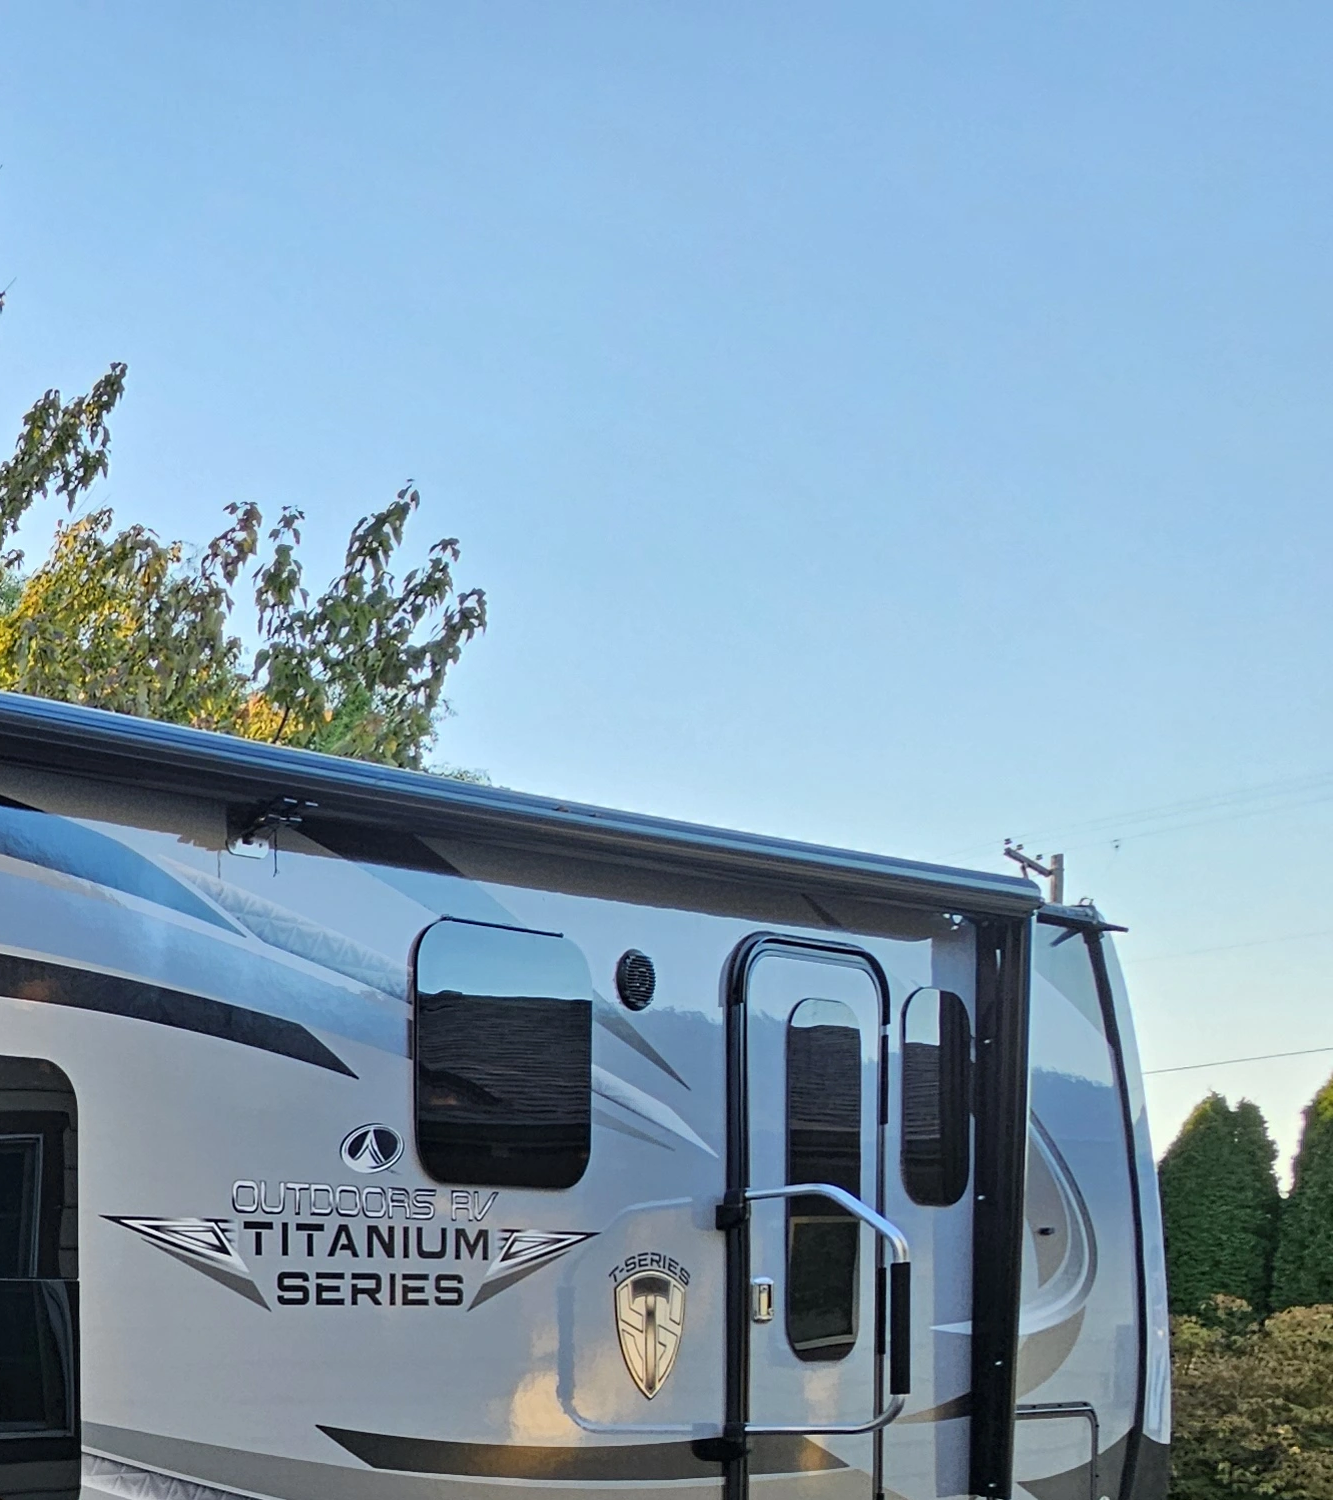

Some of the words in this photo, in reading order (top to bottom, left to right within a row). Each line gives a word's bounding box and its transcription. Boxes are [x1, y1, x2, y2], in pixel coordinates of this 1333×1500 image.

[232, 1179, 437, 1221] OUTDOORS
[451, 1189, 499, 1222] RV
[243, 1221, 489, 1261] TITANIUM
[608, 1251, 691, 1287] T-SERIES
[276, 1271, 465, 1307] SERIES
